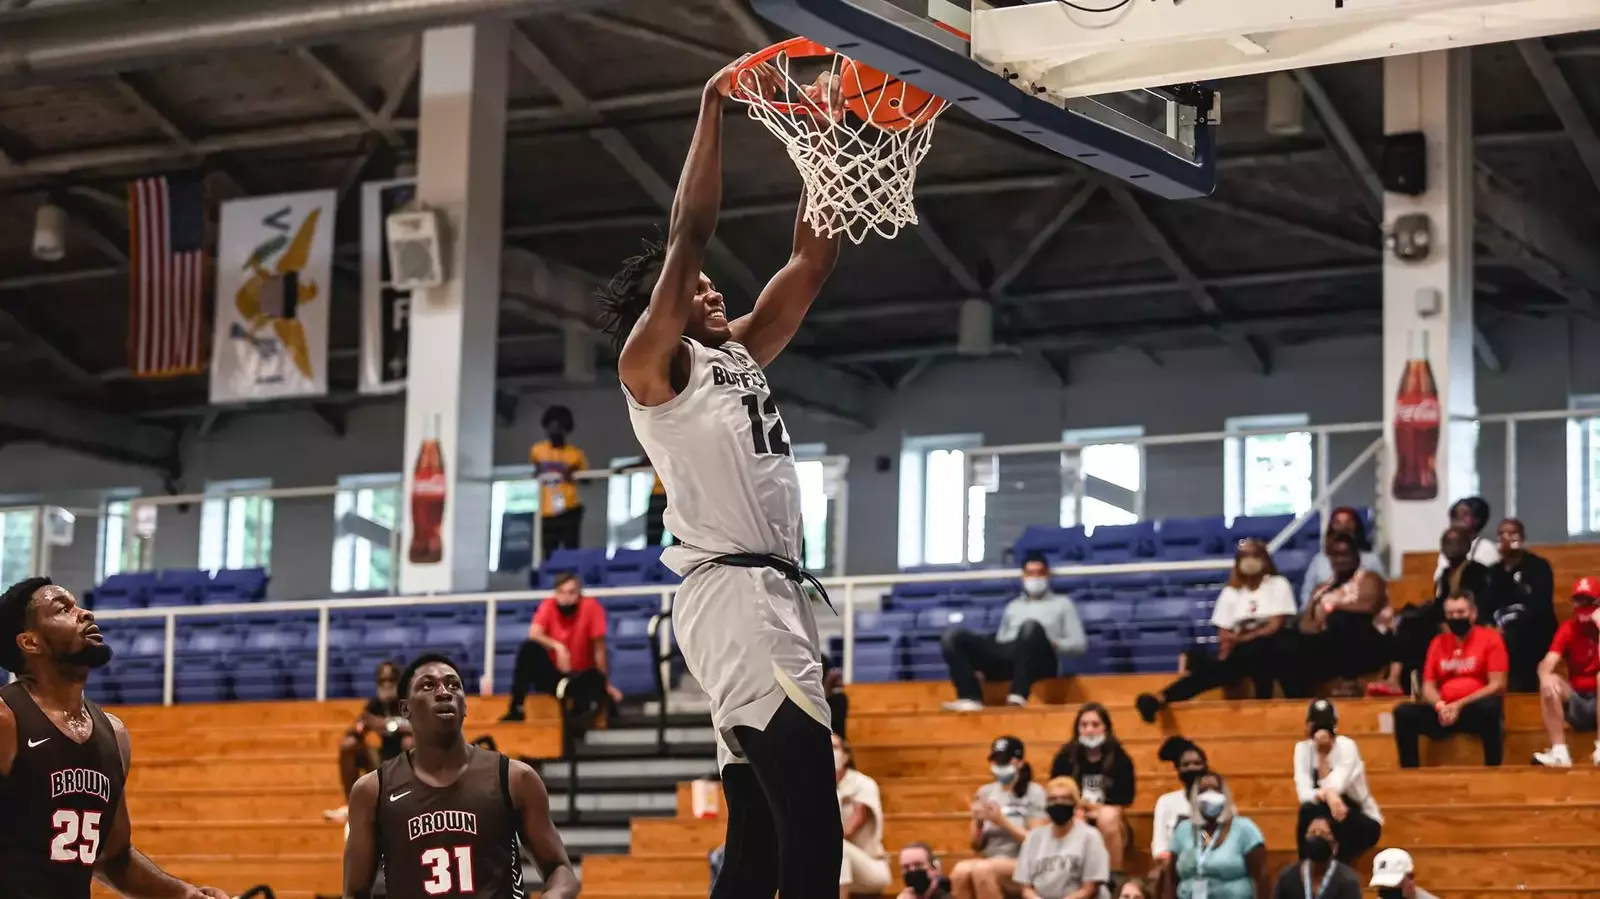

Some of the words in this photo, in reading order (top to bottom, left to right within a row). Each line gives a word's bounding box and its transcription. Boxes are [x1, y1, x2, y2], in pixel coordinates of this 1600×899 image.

[741, 394, 790, 456] 12
[51, 768, 111, 803] BROWN
[50, 809, 102, 864] 25
[408, 810, 478, 841] BROWN
[421, 846, 474, 895] 31
